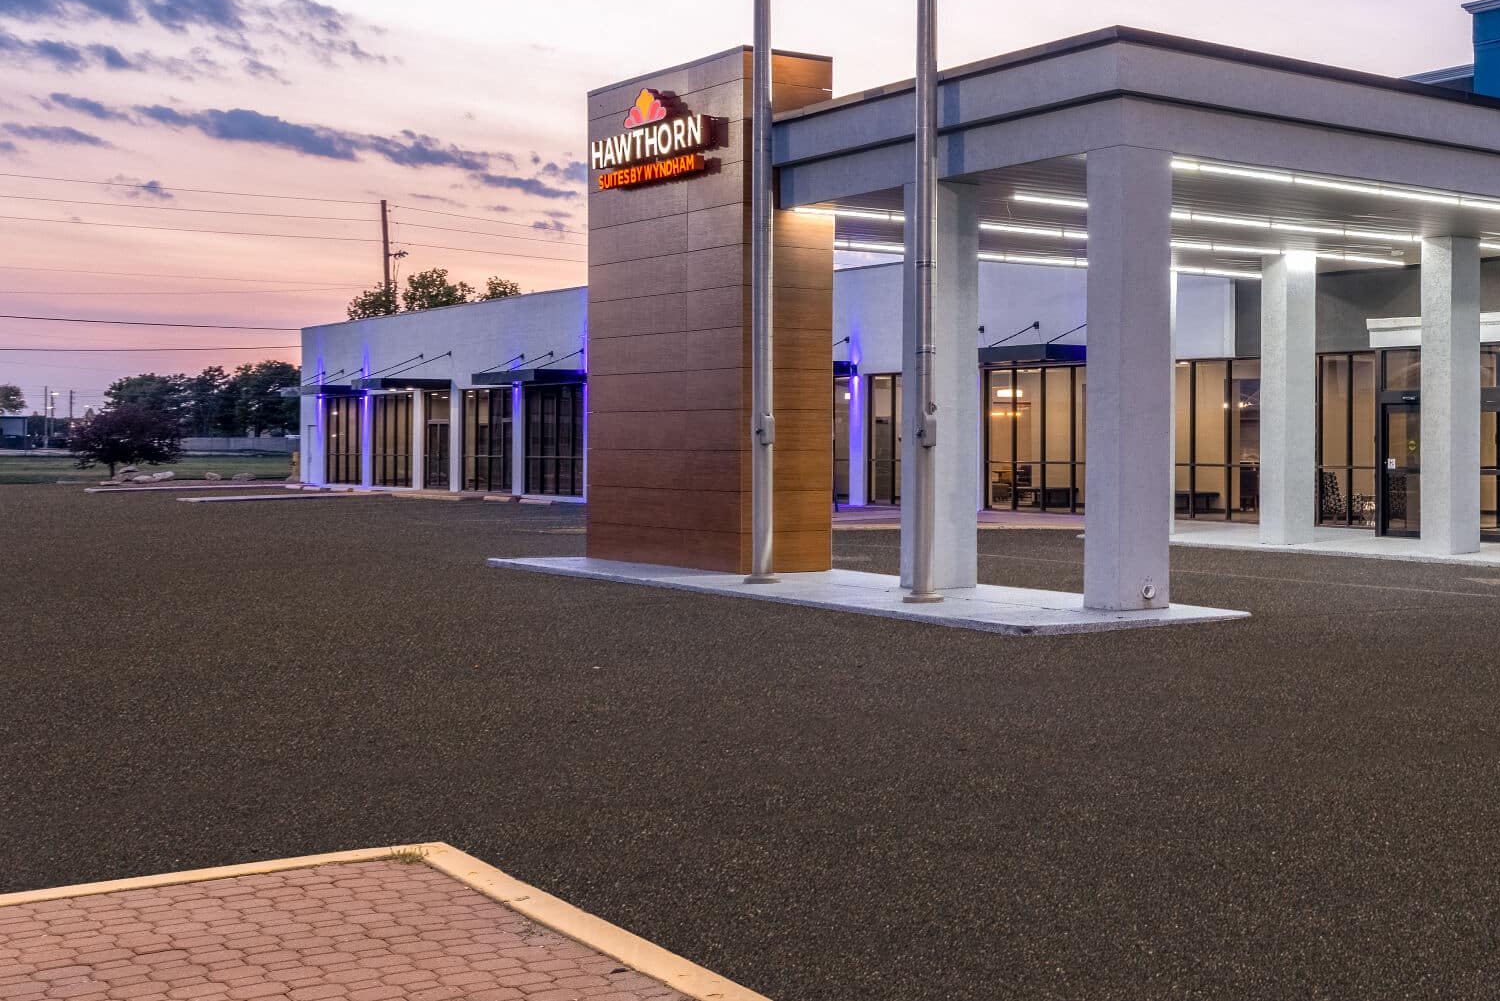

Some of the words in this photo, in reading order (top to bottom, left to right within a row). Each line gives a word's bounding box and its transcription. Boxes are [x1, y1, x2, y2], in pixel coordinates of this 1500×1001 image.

[592, 114, 702, 169] HAWTHORN
[599, 169, 630, 190] SUITES
[631, 166, 643, 183] BY
[644, 154, 695, 181] WYNDHAM
